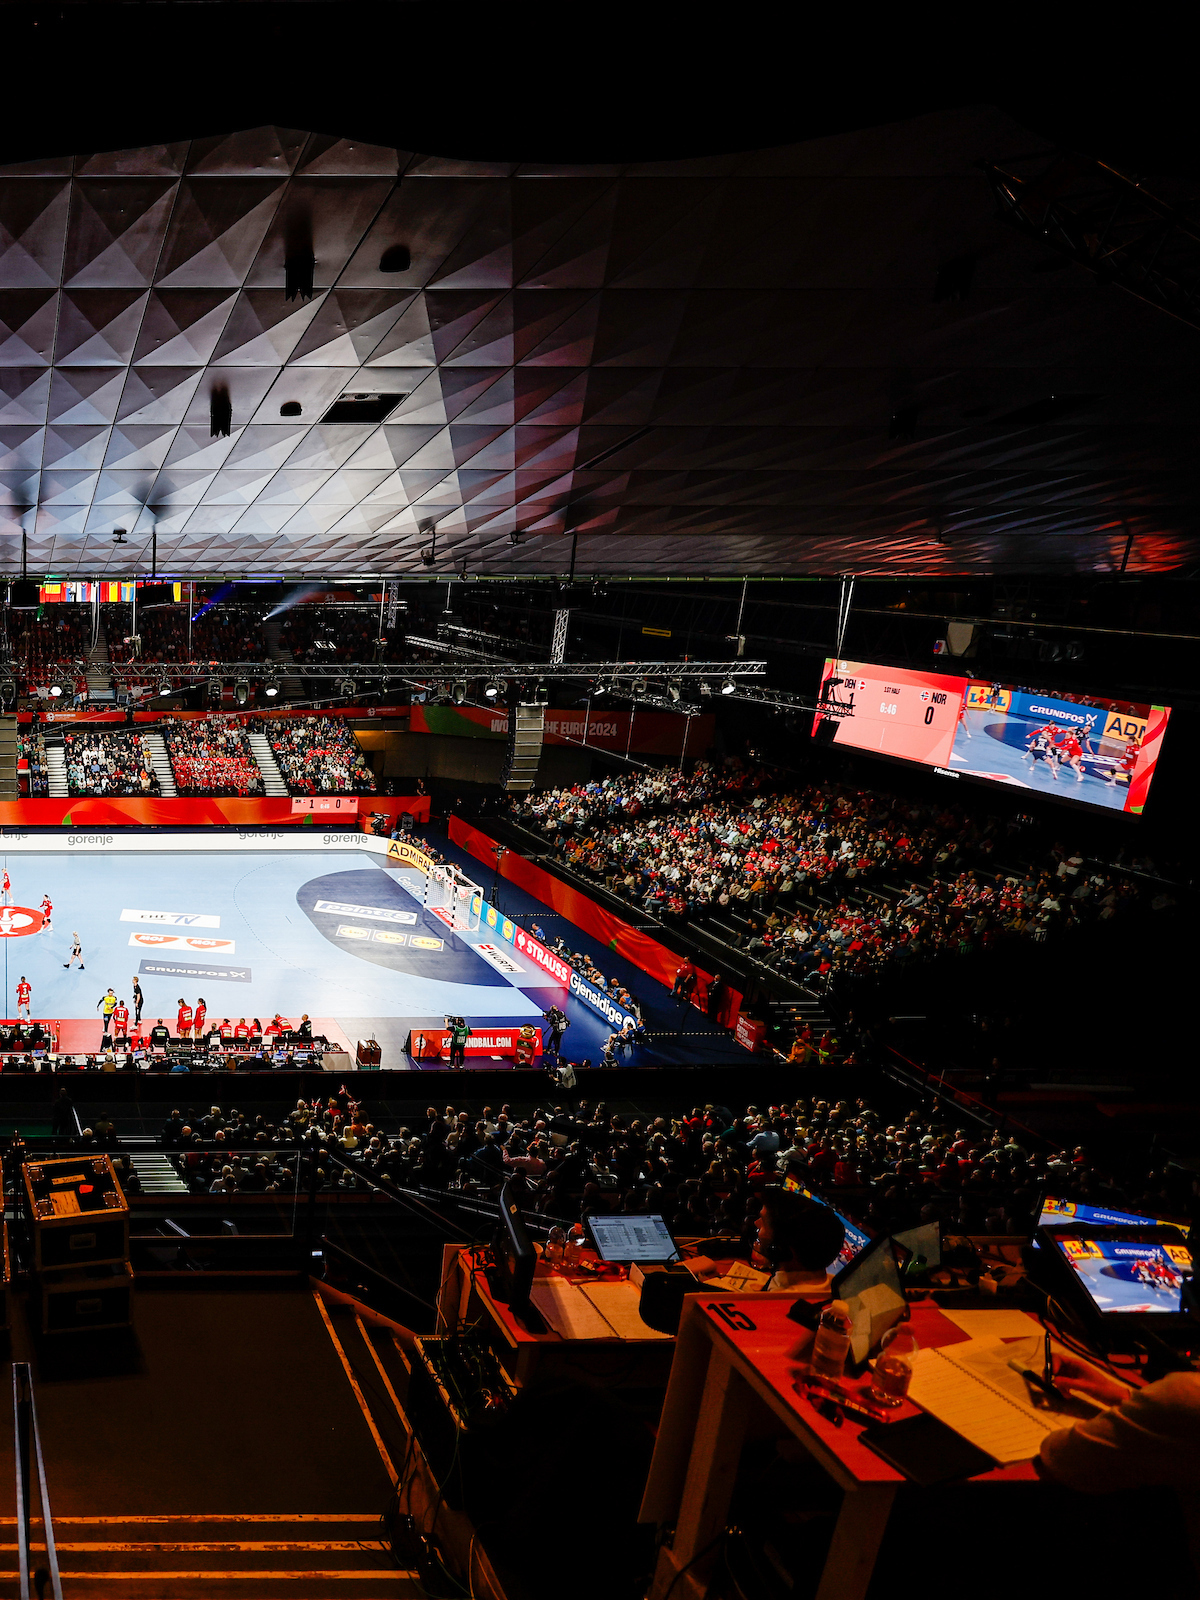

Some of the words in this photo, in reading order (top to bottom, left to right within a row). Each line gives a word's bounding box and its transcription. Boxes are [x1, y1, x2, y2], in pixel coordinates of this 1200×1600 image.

[844, 678, 857, 689] DEN
[931, 692, 948, 705] NOR
[879, 702, 897, 715] 6:46
[1029, 704, 1085, 724] GRUNDFOS
[924, 706, 935, 725] 0
[560, 721, 586, 735] EURO
[588, 723, 618, 736] 2024
[933, 766, 960, 779] Hisense
[67, 834, 113, 846] gorenje
[323, 833, 368, 845] gorenje
[398, 876, 425, 897] Gerflor
[171, 914, 201, 925] TV
[526, 940, 568, 982] STRAUSS
[144, 965, 228, 977] GRUNDFOS
[570, 973, 624, 1024] Gjensidige
[1093, 1212, 1138, 1225] GRUNDFOS
[707, 1303, 757, 1331] 15
